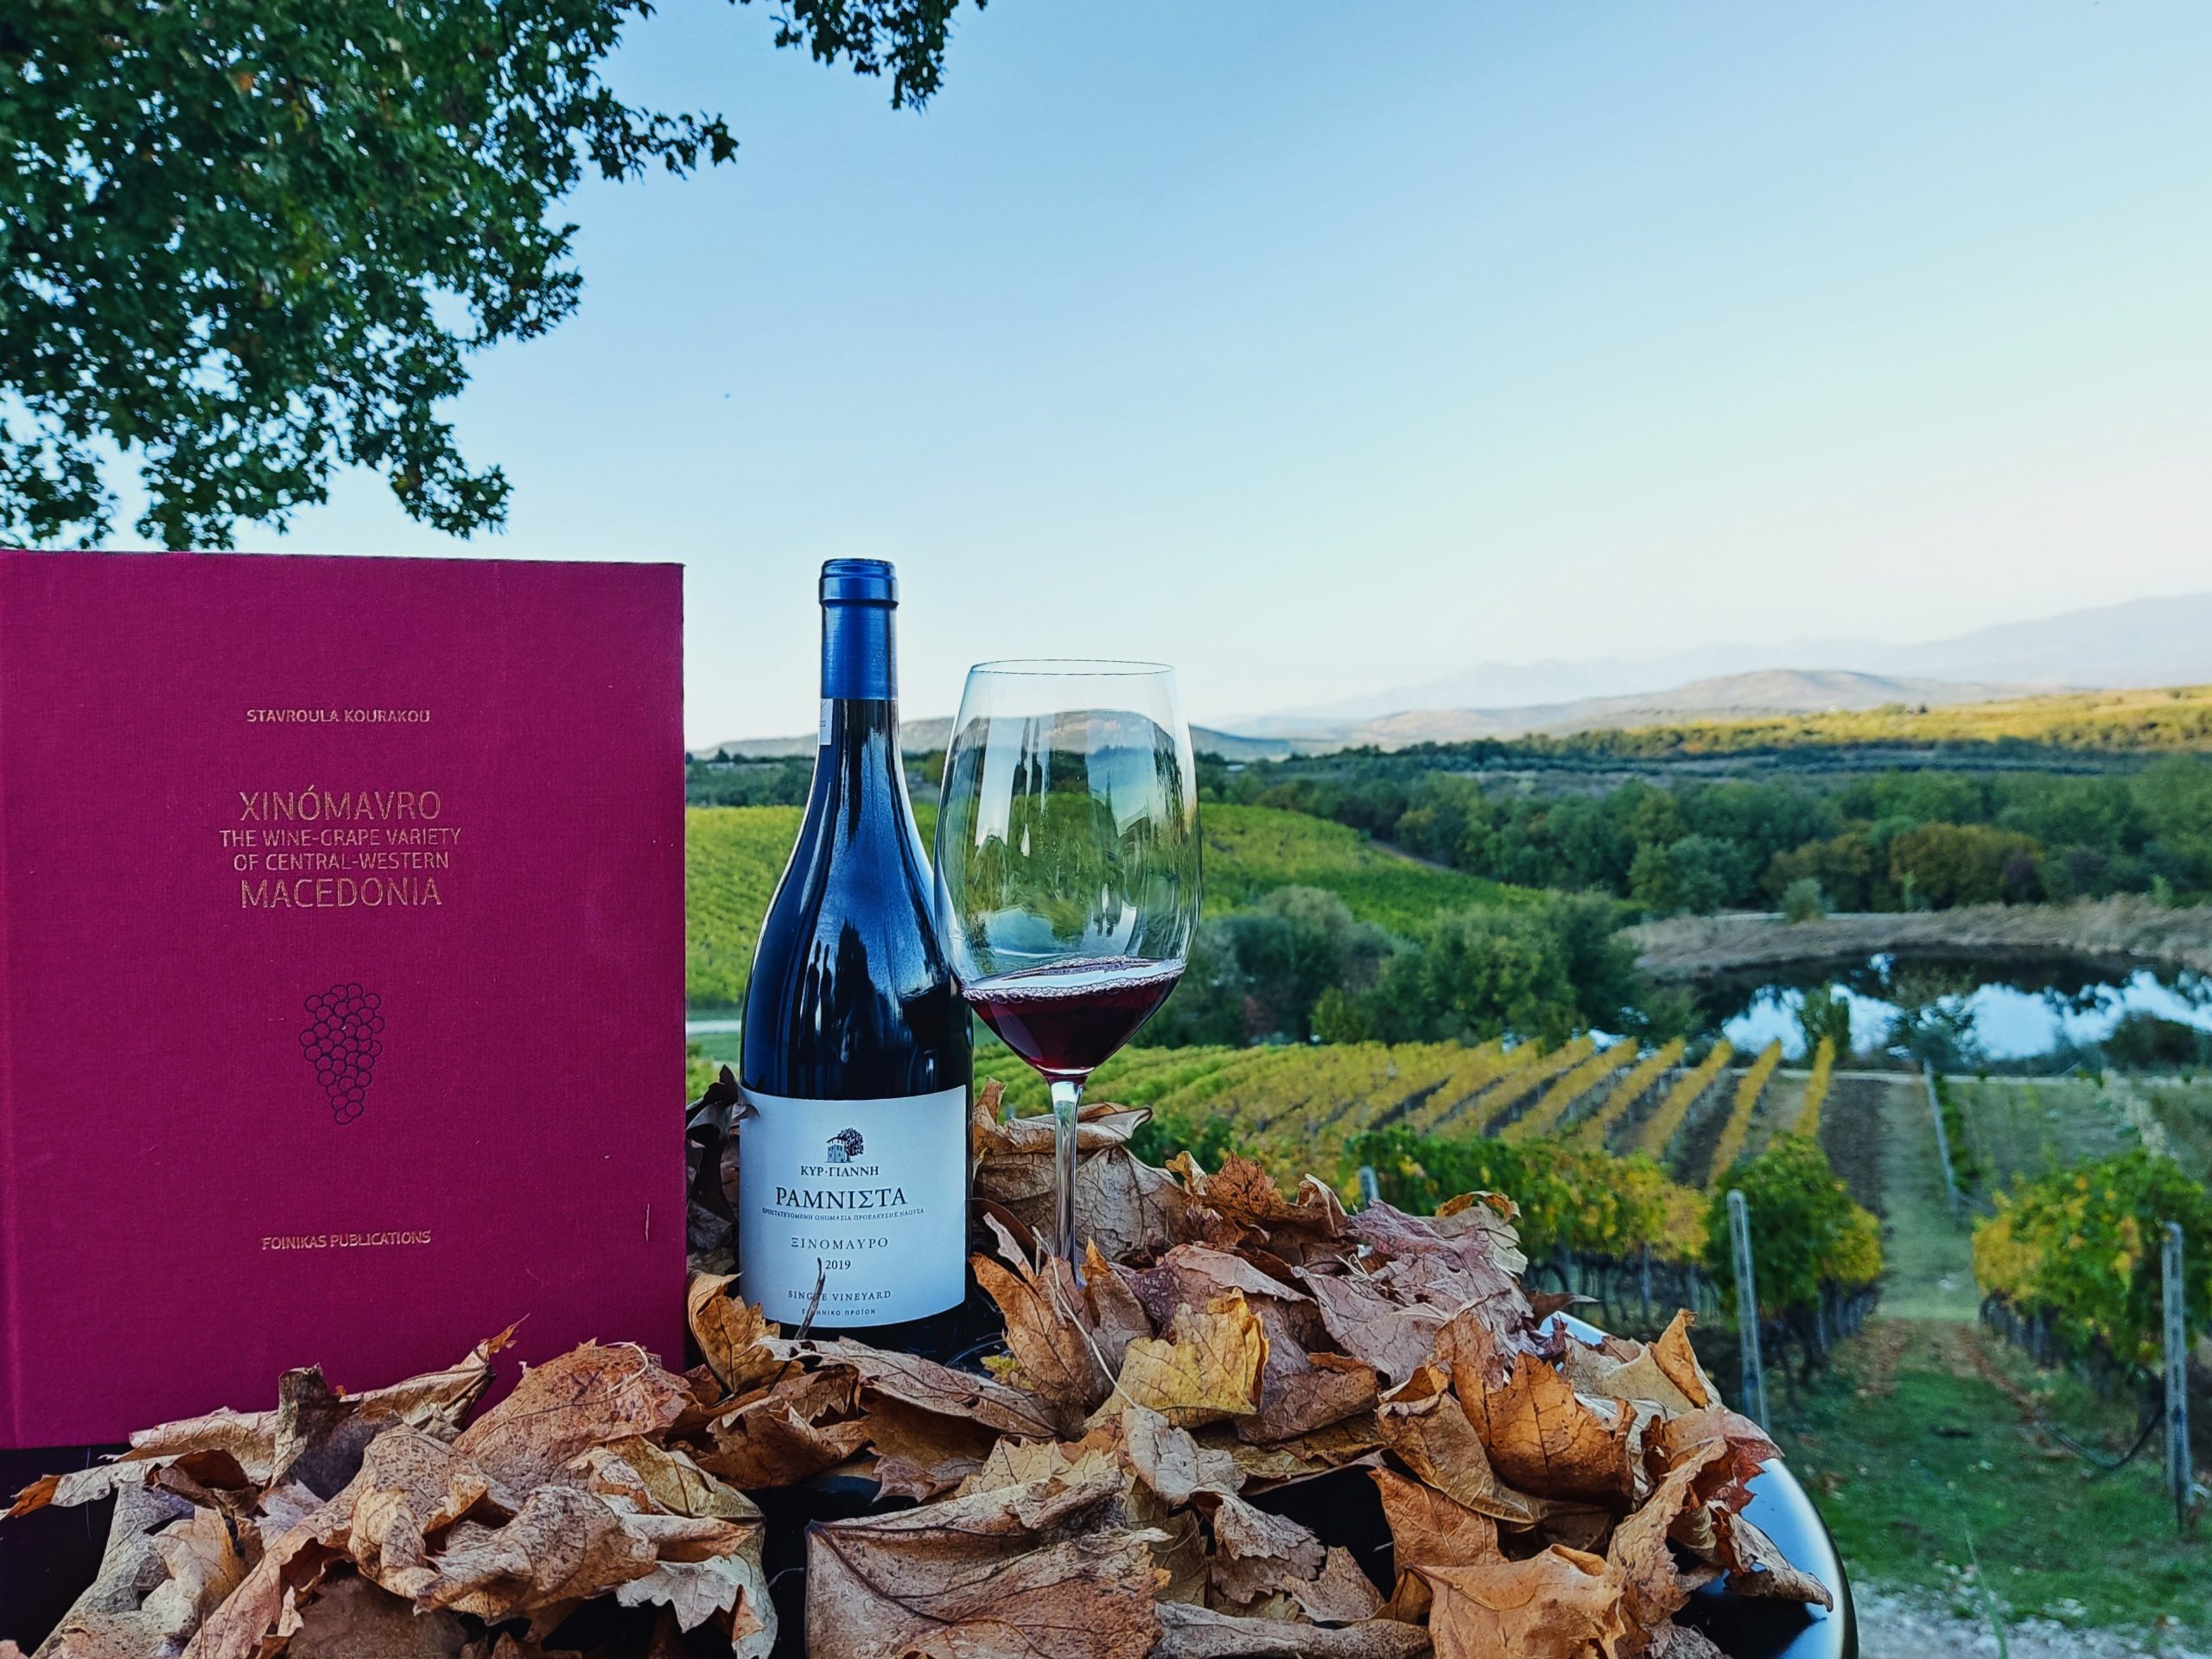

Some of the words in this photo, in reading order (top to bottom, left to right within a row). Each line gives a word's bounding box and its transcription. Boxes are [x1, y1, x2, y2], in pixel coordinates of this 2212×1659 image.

[245, 709, 340, 724] STAVROULA
[344, 709, 430, 724] KOURAKOU
[238, 783, 442, 822] XINÓMAVRO
[219, 829, 257, 849] THE
[262, 828, 381, 848] WINE-GRAPE
[385, 826, 463, 847] VARIETY
[232, 853, 259, 872] OF
[264, 850, 449, 871] CENTRAL-WESTERN
[240, 875, 443, 909] MACEDONIA
[775, 1186, 908, 1210] ΡΑΜΝΙΣΤΑ
[899, 1208, 925, 1217] ΝΑΟΥΣΑ
[261, 1234, 327, 1251] FOINIKAS
[329, 1230, 432, 1248] PUBLICATIONS
[791, 1236, 888, 1250] ΞΙΝΟΜΑΥΡΟ
[824, 1259, 851, 1270] 2019
[787, 1290, 828, 1301] SINGE
[831, 1290, 892, 1301] VINEYARD
[801, 1307, 841, 1317] ΕΗΝΙΚΟ
